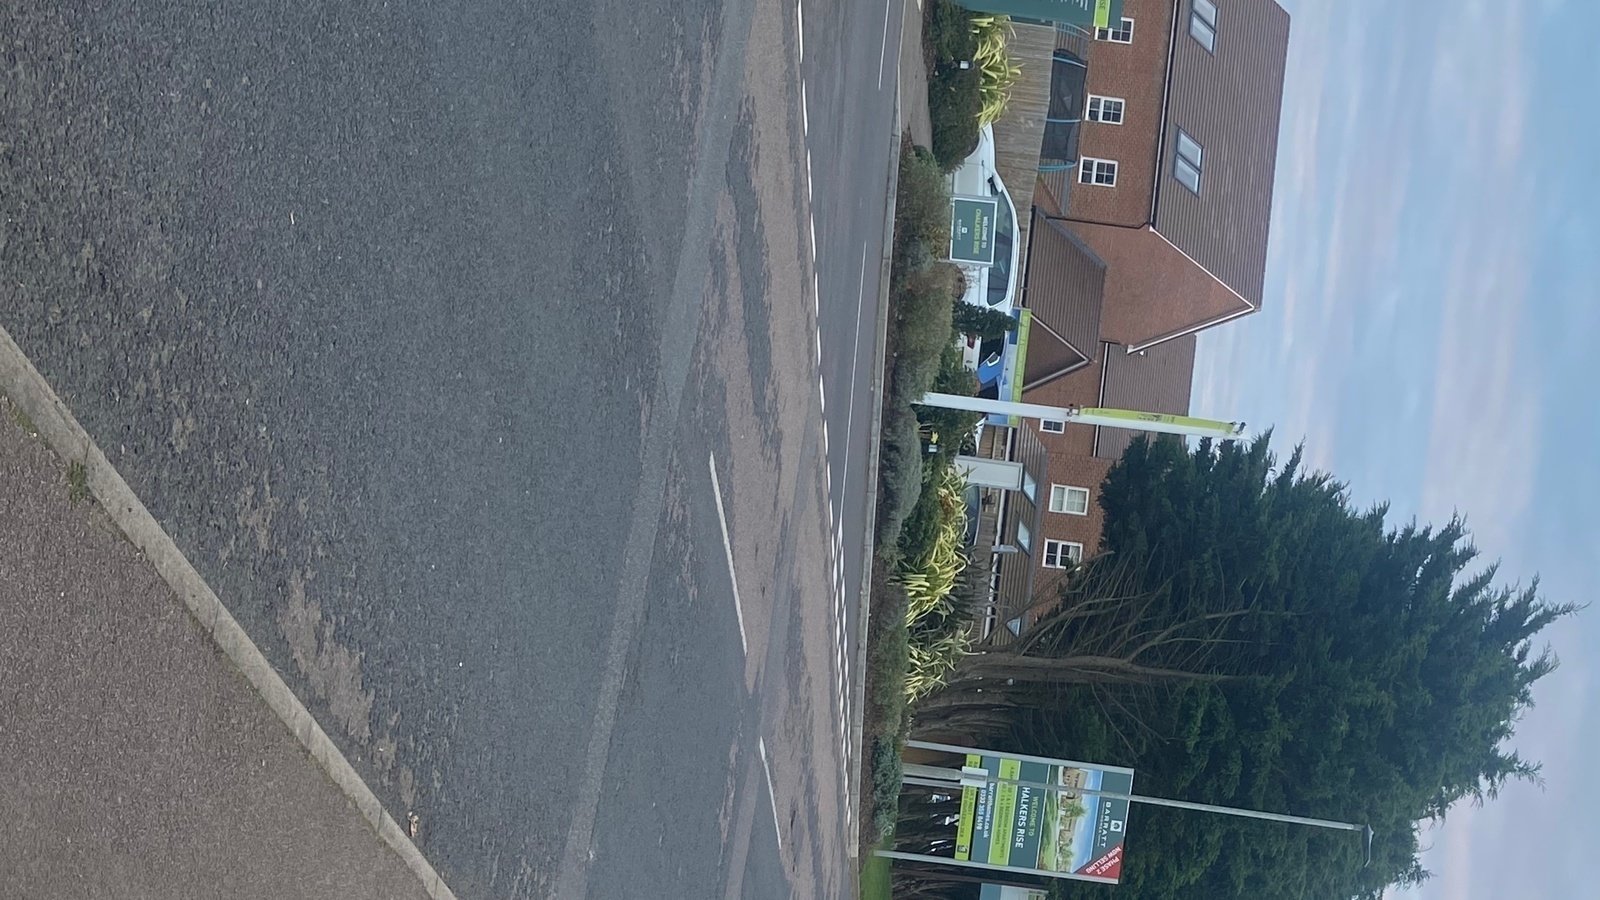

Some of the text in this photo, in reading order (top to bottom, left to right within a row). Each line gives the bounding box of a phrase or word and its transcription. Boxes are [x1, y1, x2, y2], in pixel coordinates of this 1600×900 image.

[983, 782, 995, 838] barratthomes.co.uk
[1015, 786, 1031, 849] HALKERS RISE
[1028, 796, 1039, 837] WELCOME TO
[1100, 801, 1112, 848] BARRATT
[1085, 846, 1122, 874] NOW SELLING
[1100, 856, 1120, 872] PHASE
